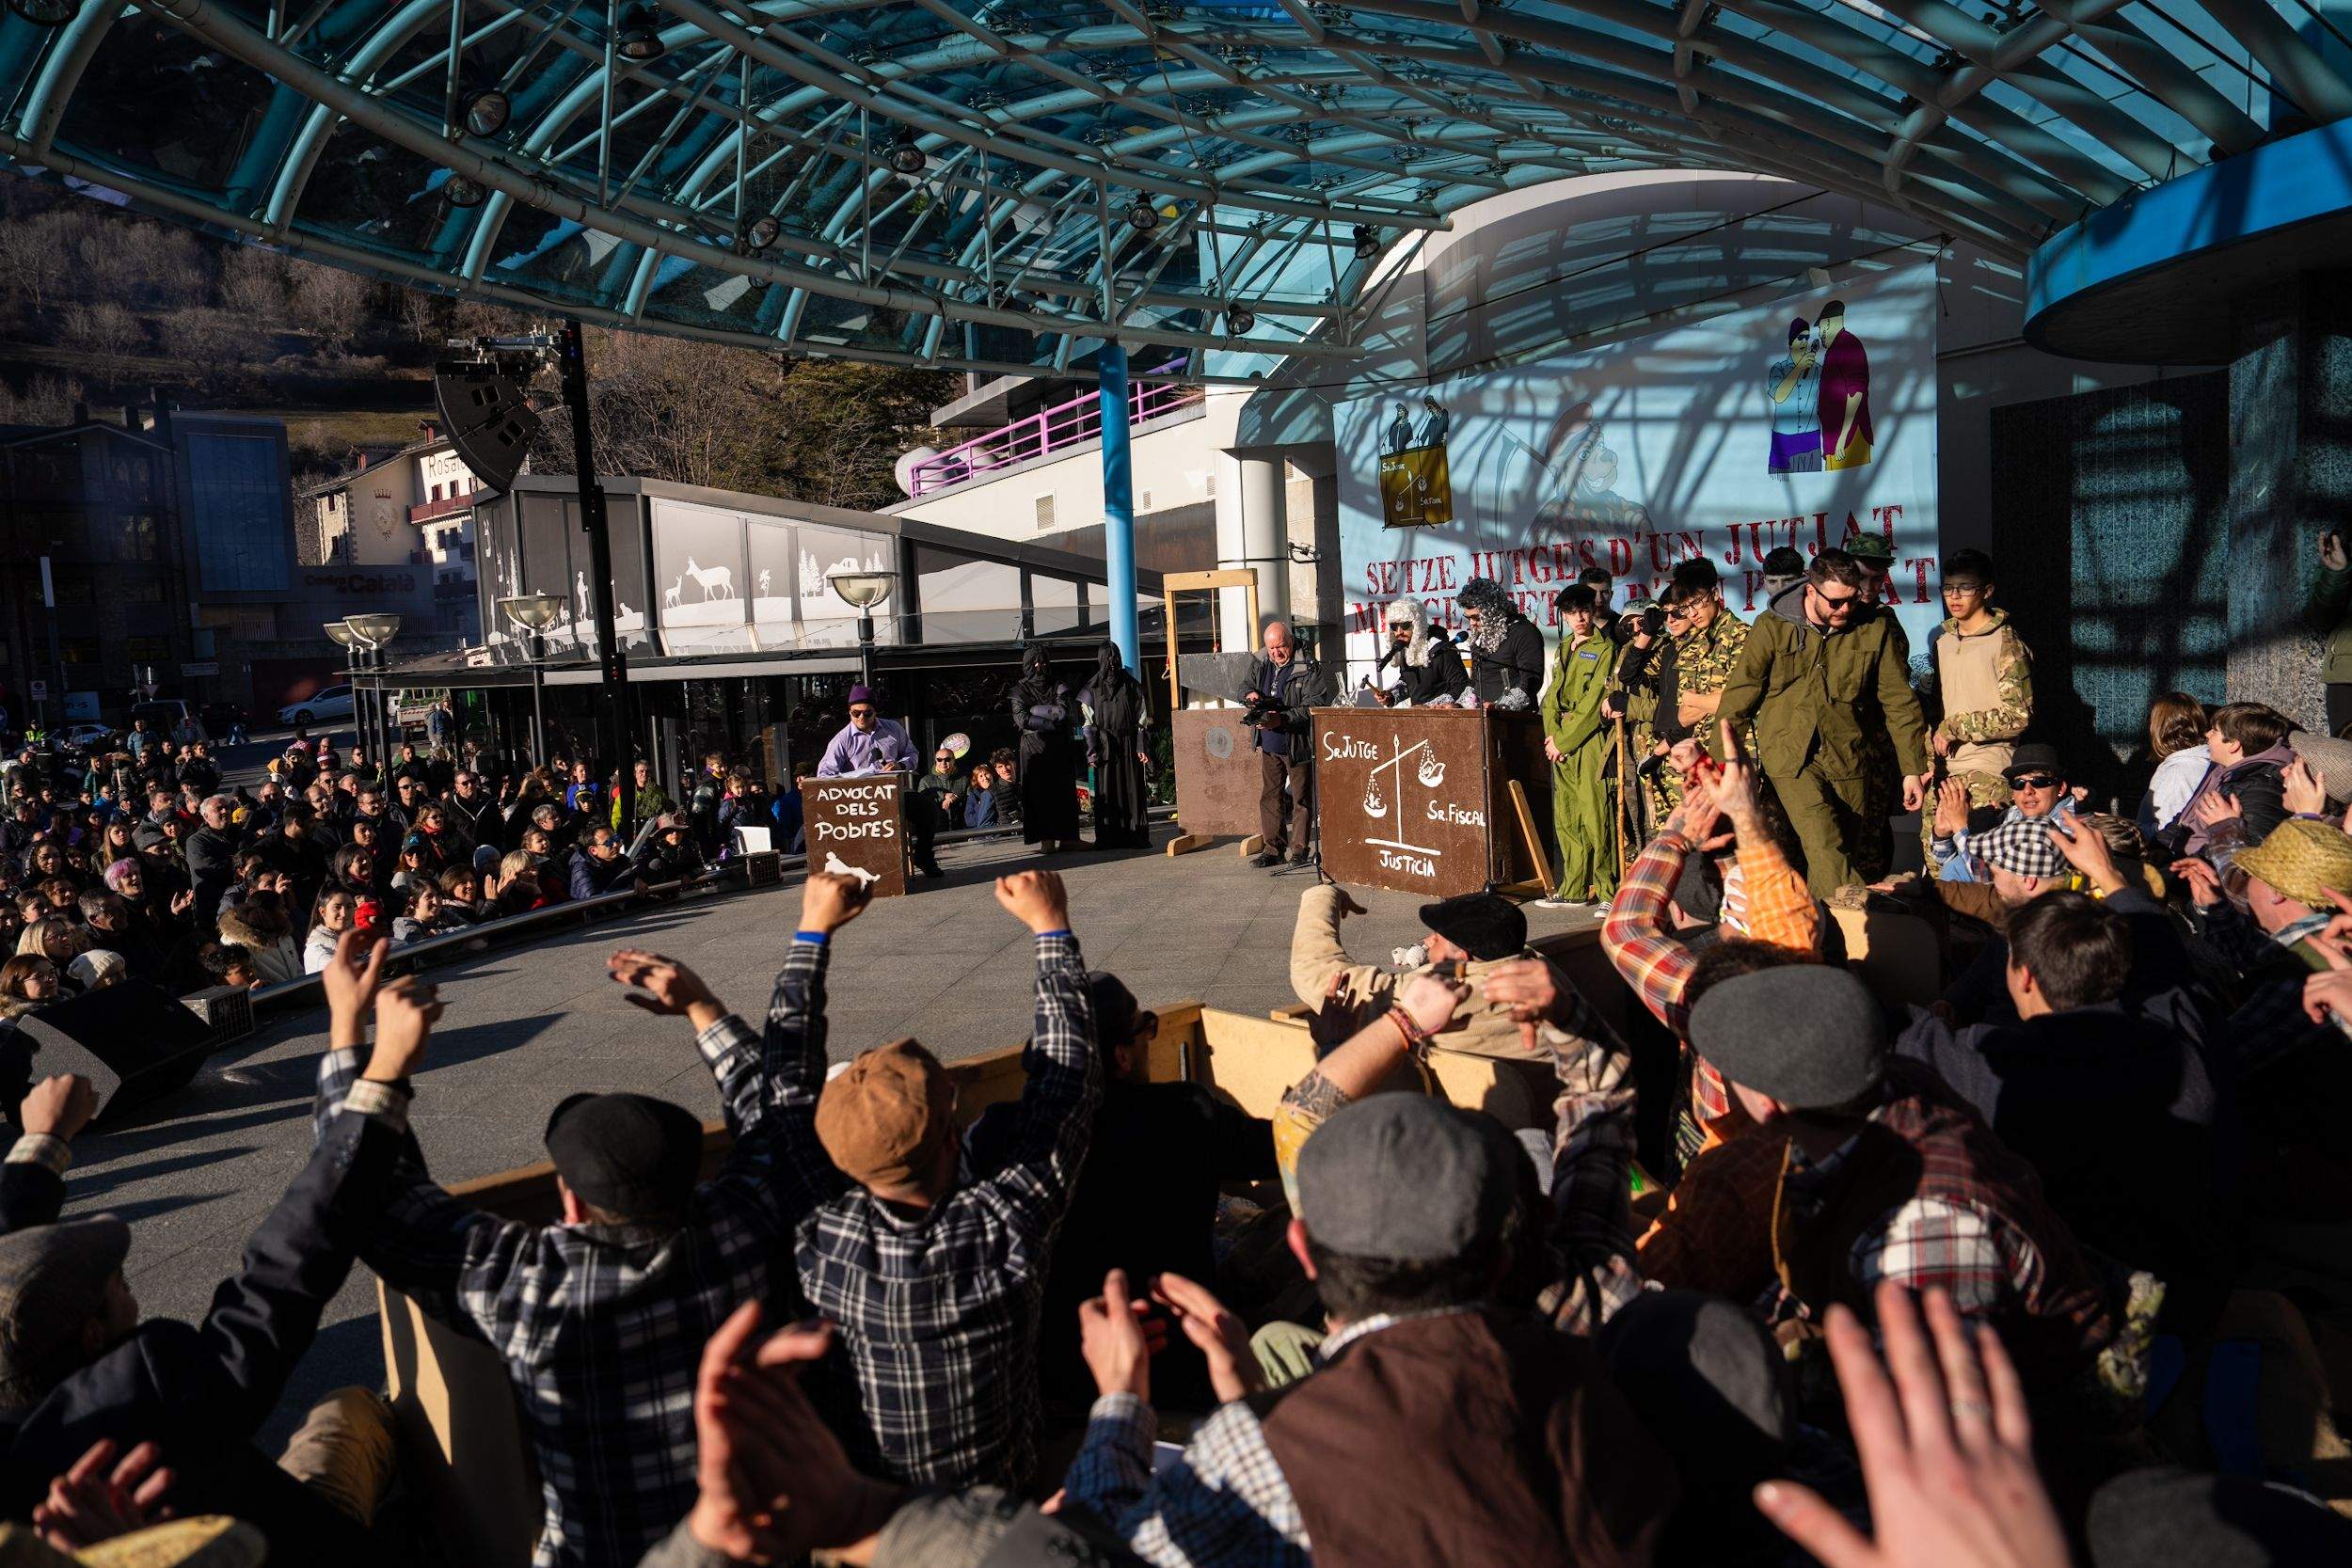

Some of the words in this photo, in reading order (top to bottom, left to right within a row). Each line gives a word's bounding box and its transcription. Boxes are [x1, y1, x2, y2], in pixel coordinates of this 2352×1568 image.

[1367, 555, 1456, 595] SETZE
[1468, 539, 1596, 585] JUTGES
[1608, 531, 1705, 577] D'UN
[1724, 504, 1903, 565] JUTJAT
[349, 573, 415, 594] Català
[817, 784, 898, 801] ADVOCAT
[835, 802, 880, 816] DELS
